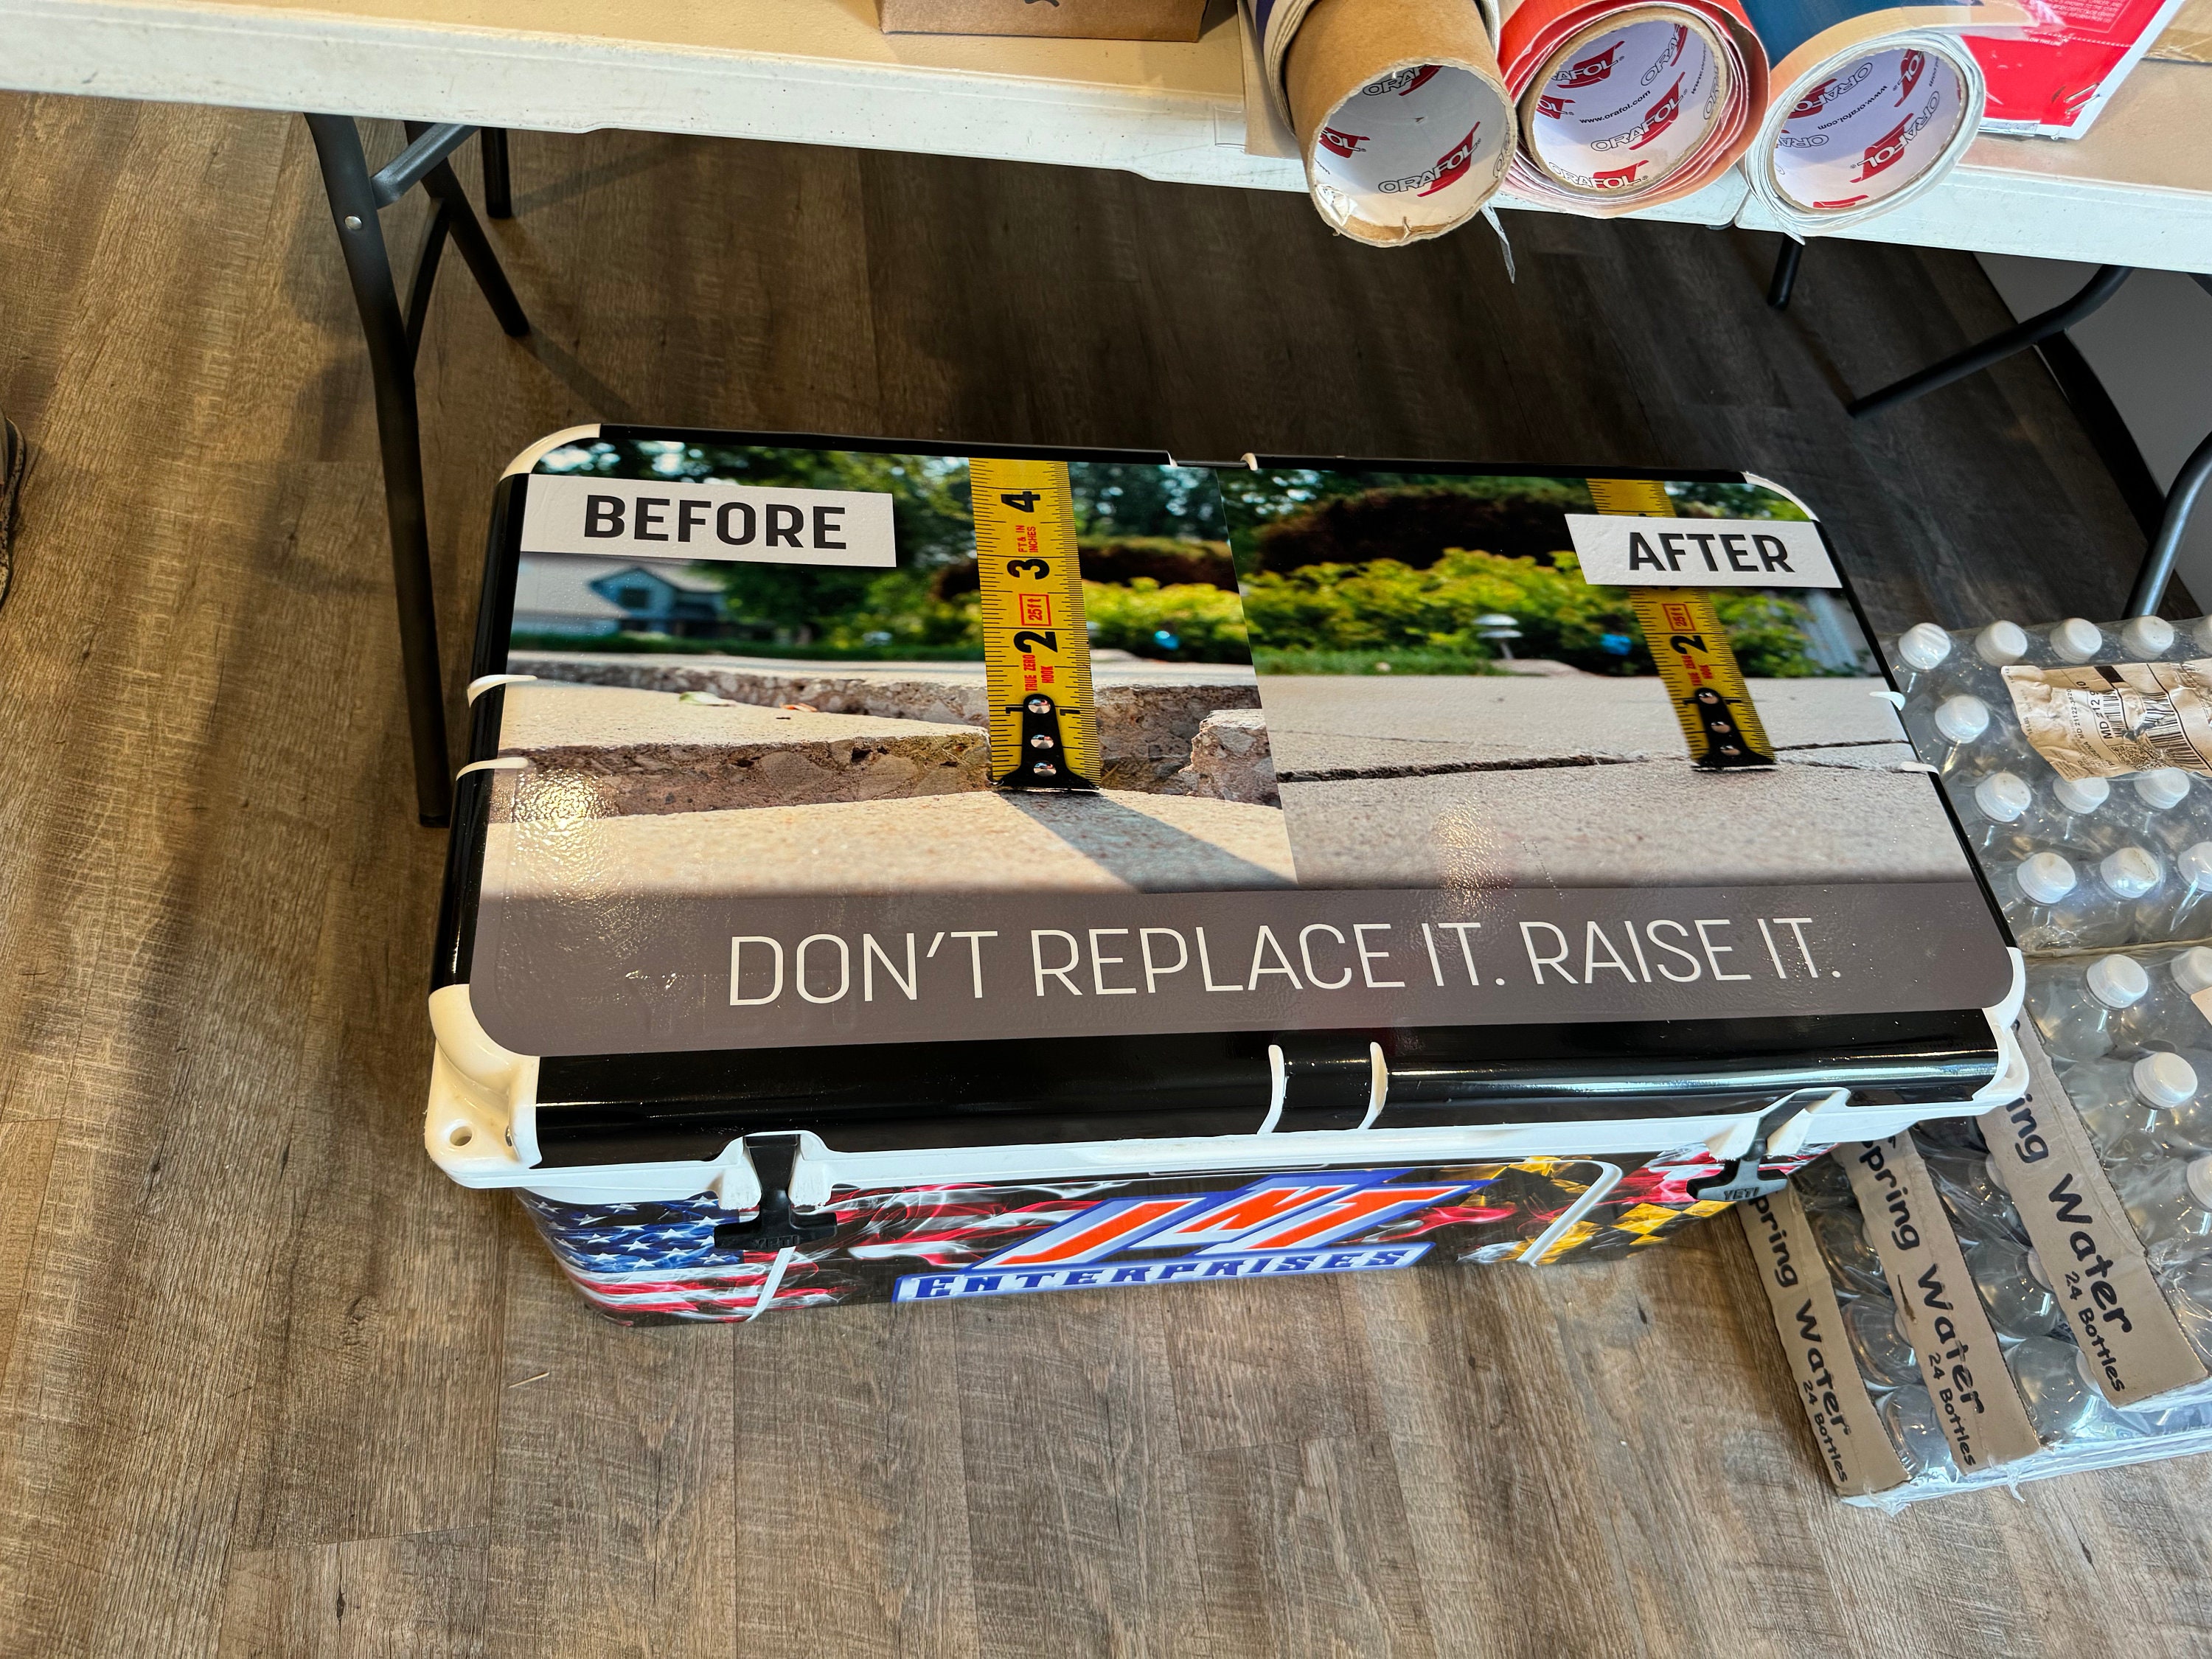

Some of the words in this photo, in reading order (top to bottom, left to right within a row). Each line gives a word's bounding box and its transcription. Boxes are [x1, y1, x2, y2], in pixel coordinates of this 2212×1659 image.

[1579, 90, 1651, 124] www.orafol.com
[1791, 62, 1874, 113] ORAFO
[1818, 85, 1888, 131] www.orafol.com
[584, 494, 847, 550] BEFORE
[1000, 490, 1041, 513] 4
[1026, 526, 1039, 553] INCHES
[1628, 532, 1796, 573] AFTER
[1006, 558, 1050, 580] 3
[1013, 630, 1058, 653] 2
[1669, 634, 1709, 655] 2
[1022, 654, 1037, 672] ZERO
[1024, 674, 1038, 692] TRUE
[1040, 665, 1055, 684] HOOK
[2099, 720, 2113, 740] MD
[728, 930, 999, 1006] DON'T
[1029, 922, 1406, 998] REPLACE
[1420, 922, 1506, 988] IT.
[1518, 919, 1752, 985] RAISE
[1756, 917, 1842, 980] IT.
[1723, 1186, 1760, 1200] YETI
[913, 1249, 1407, 1299] ENTERPRISES
[2048, 1172, 2133, 1335] Water
[1858, 1135, 1920, 1251] pring
[1917, 1262, 1986, 1415] Water
[1747, 1190, 1800, 1289] pring
[1795, 1298, 1851, 1436] Water
[2064, 1270, 2083, 1301] 24
[2078, 1306, 2126, 1393] Bottles
[1927, 1351, 1946, 1380] 24
[1938, 1387, 1978, 1470] Bottles
[1802, 1379, 1818, 1406] 24
[1813, 1411, 1848, 1484] Bottles
